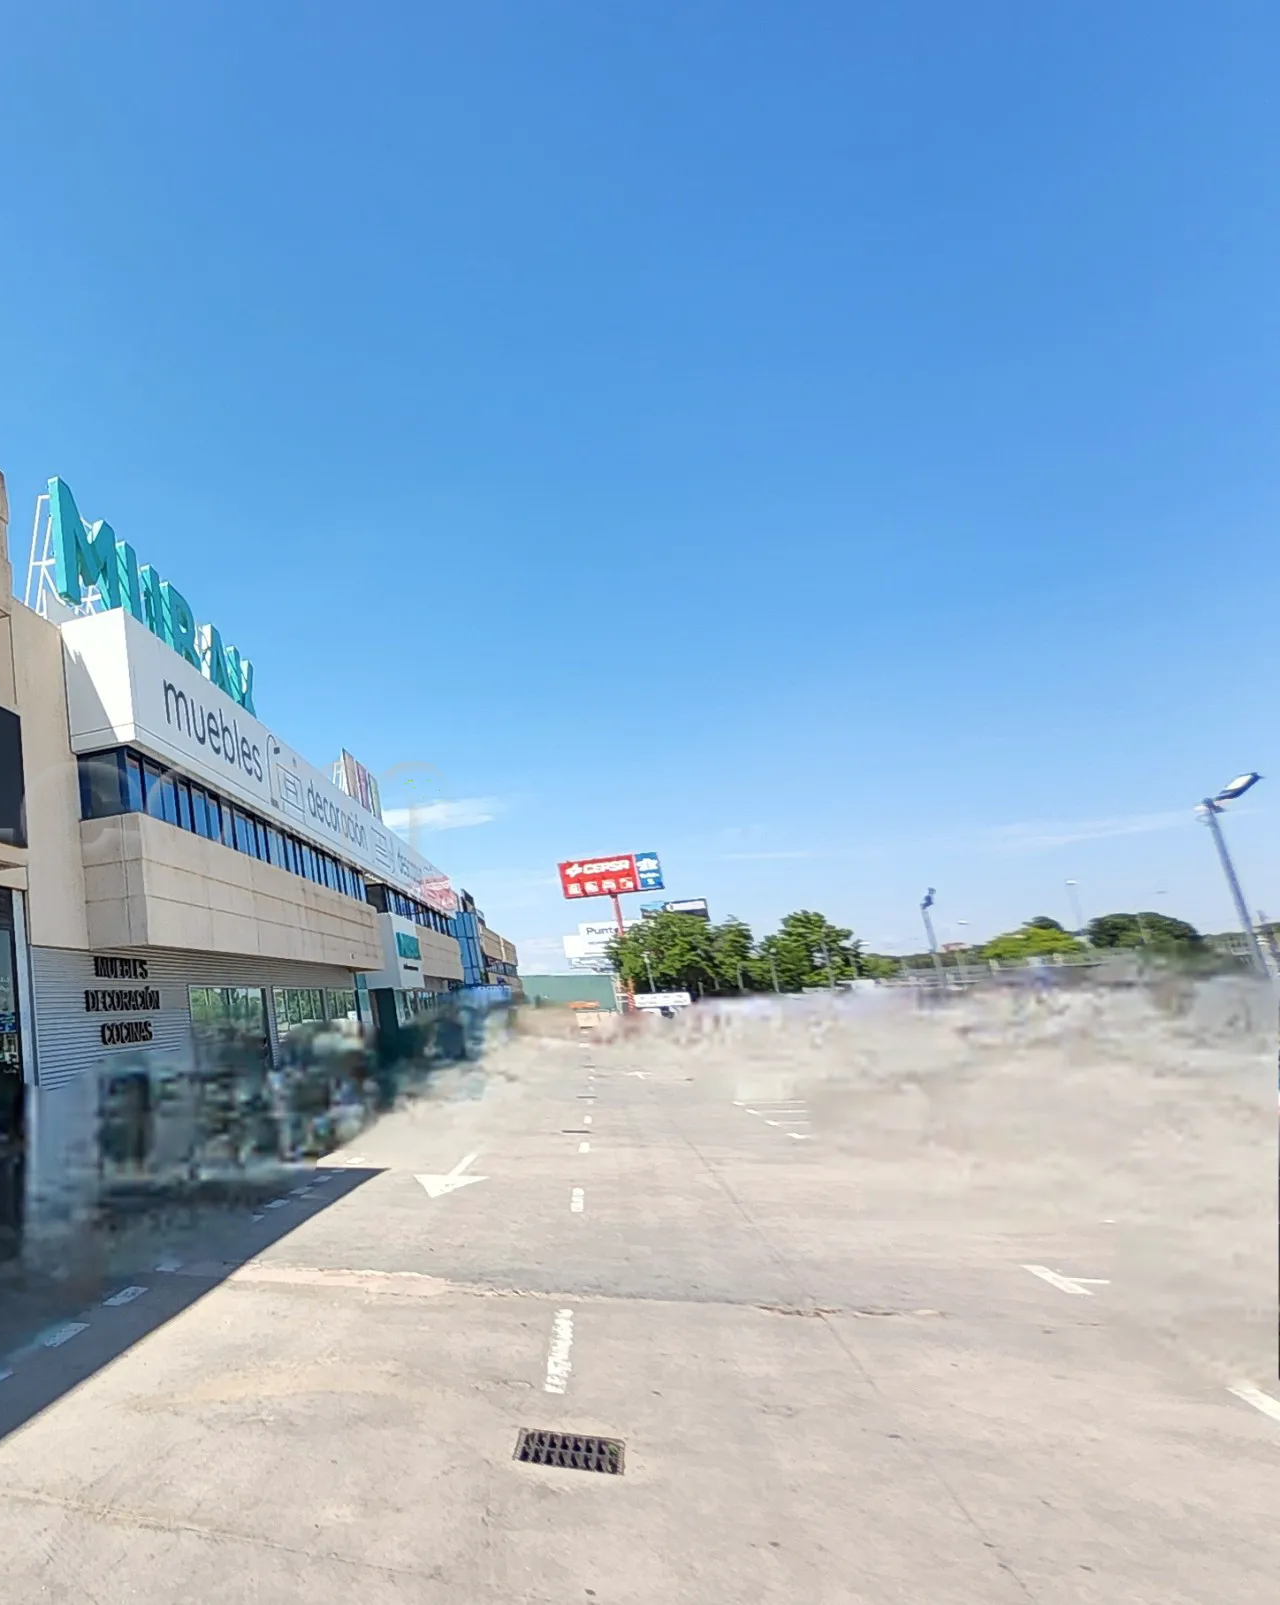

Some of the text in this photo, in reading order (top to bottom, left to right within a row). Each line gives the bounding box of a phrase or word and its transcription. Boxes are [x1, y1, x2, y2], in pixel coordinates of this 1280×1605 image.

[163, 679, 263, 783] muebles
[307, 779, 368, 851] decoración
[582, 860, 630, 874] CEPSA
[84, 985, 160, 1012] DECORACIÓN
[101, 1020, 153, 1045] COCINAS
